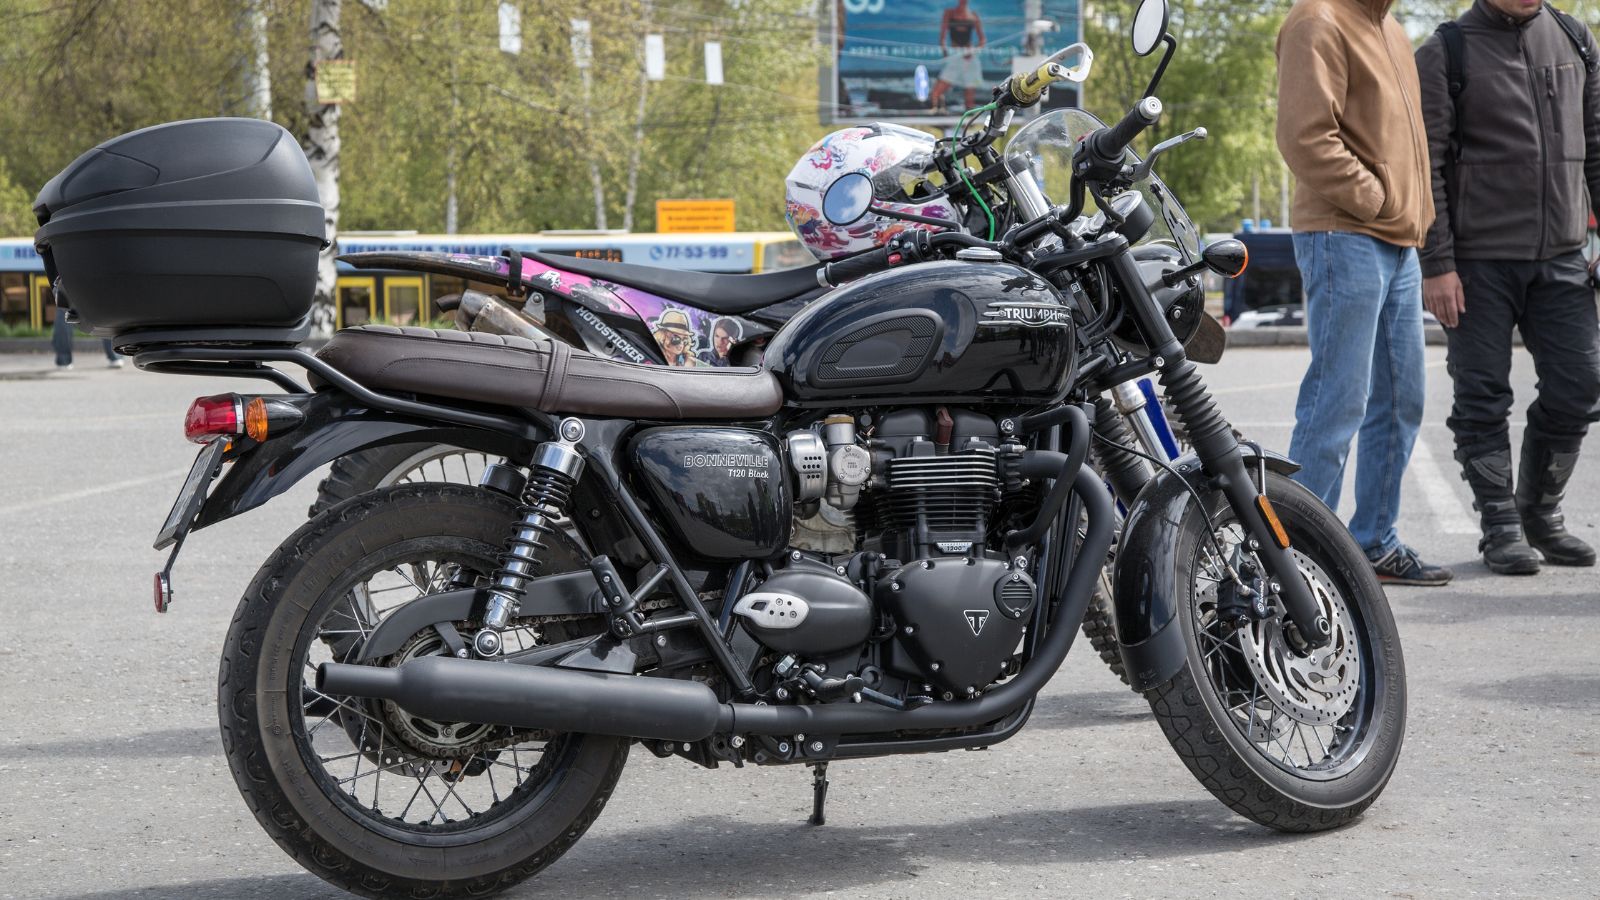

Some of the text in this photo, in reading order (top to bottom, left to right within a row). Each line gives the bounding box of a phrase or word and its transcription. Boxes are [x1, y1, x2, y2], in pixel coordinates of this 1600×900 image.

[665, 246, 728, 258] 77-53-99
[1004, 307, 1058, 323] TRIUMPH
[575, 306, 645, 363] MOTOSTICKER
[683, 454, 769, 468] BONNEVILLE
[728, 468, 769, 479] T120 Black
